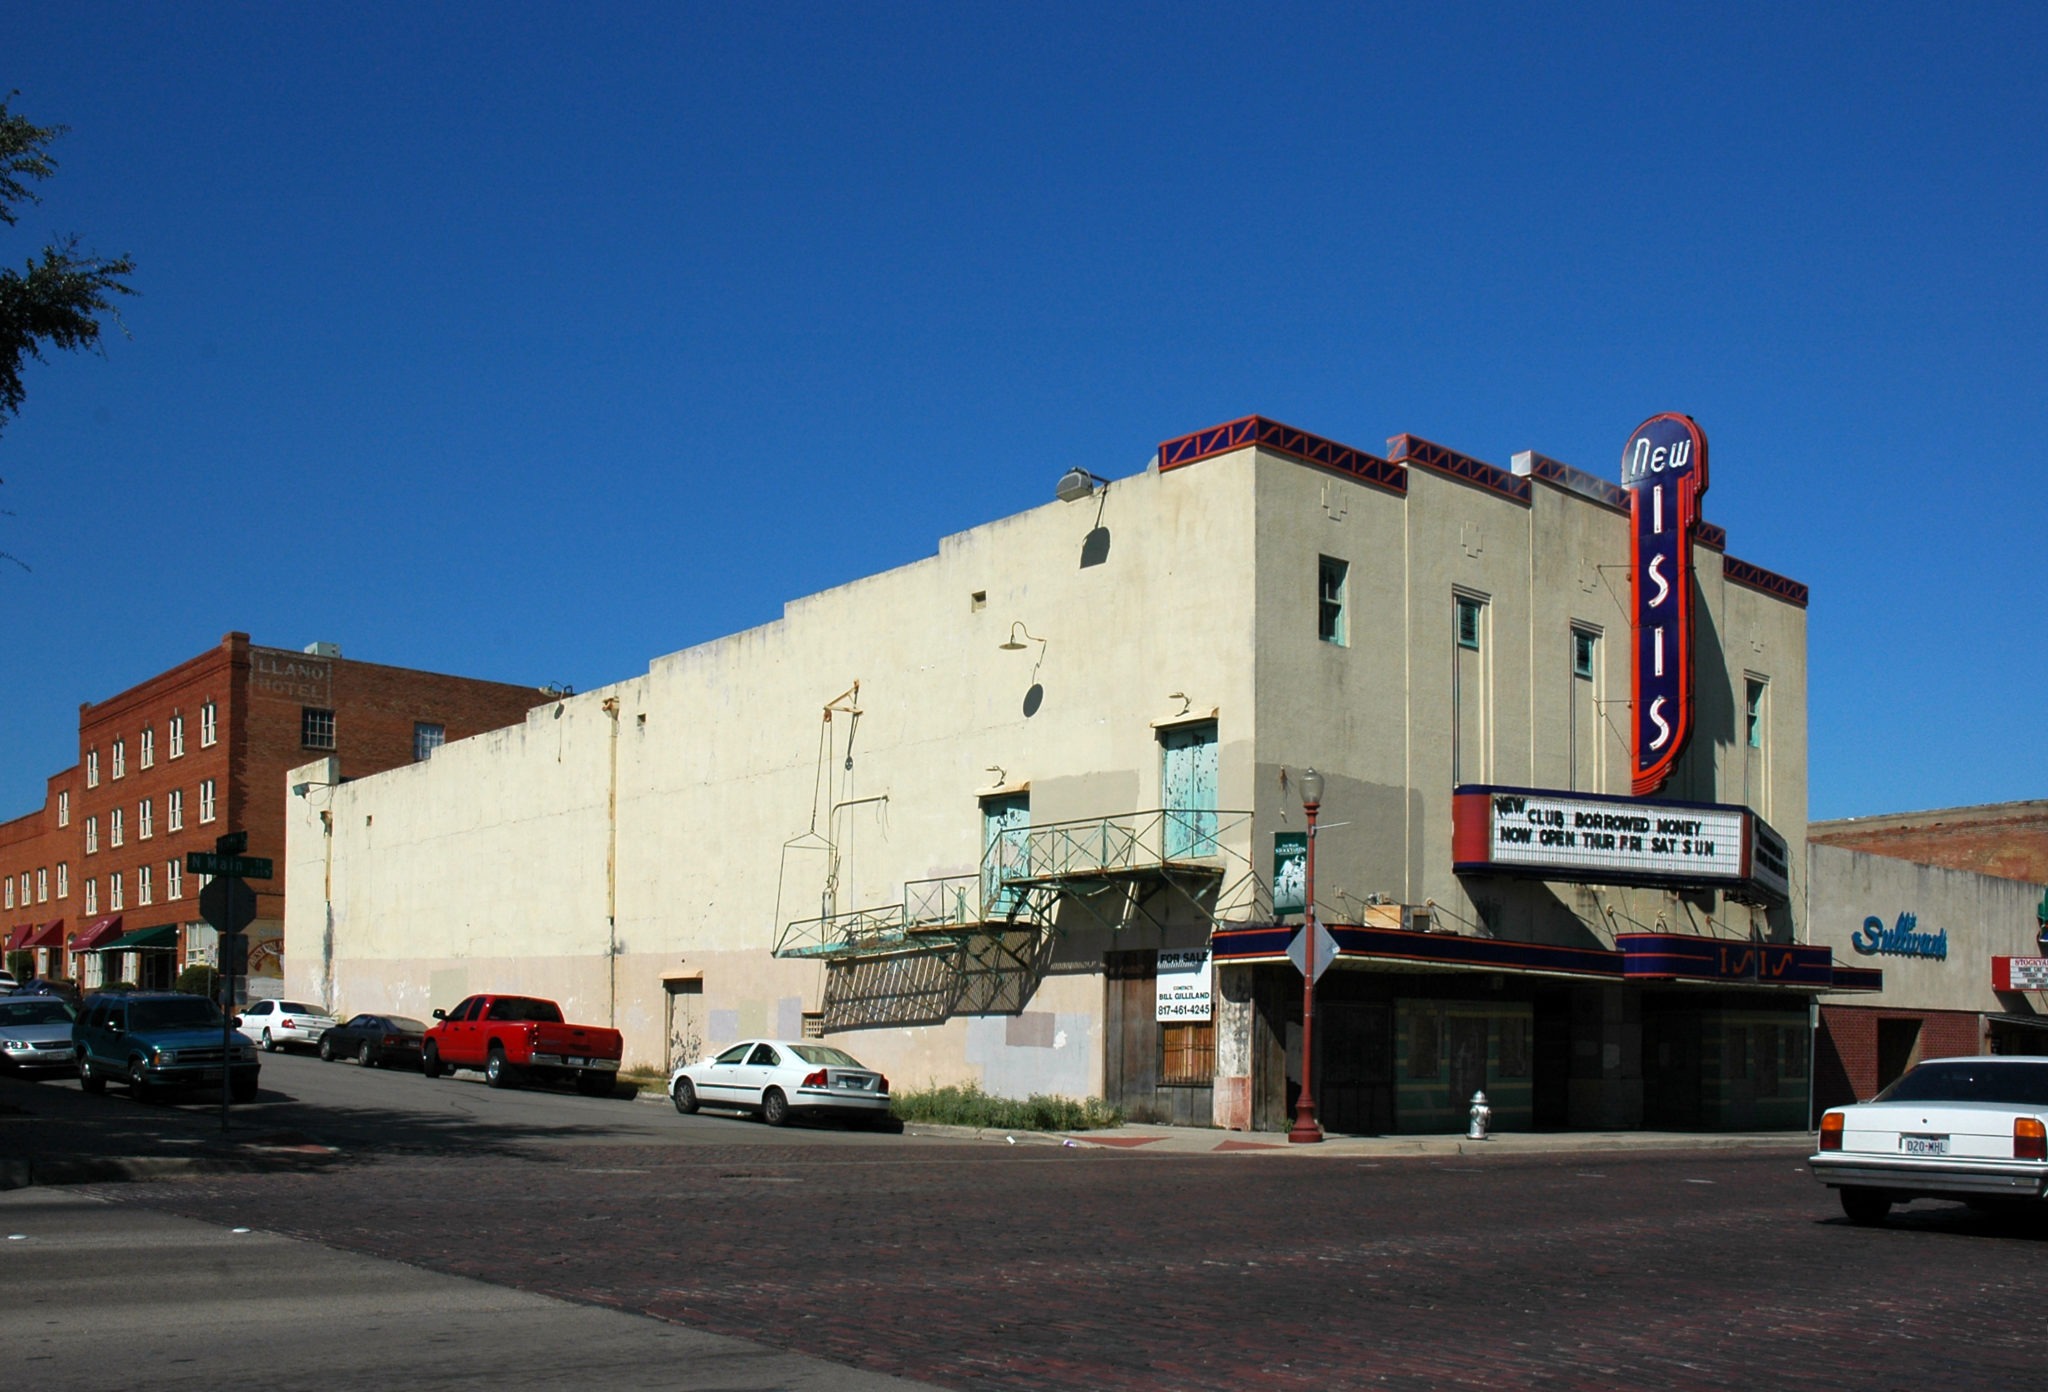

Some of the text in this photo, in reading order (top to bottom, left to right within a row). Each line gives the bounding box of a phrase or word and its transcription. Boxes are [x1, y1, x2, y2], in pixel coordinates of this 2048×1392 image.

[1648, 484, 1670, 751] ISIS
[259, 659, 325, 680] LLANO
[259, 679, 324, 699] HOTEL
[1495, 796, 1702, 837] NEW CLUB BORROWED MONEY
[1500, 826, 1532, 844] NOW
[1539, 829, 1576, 848] OPEN
[1620, 835, 1642, 853] FRI
[1651, 837, 1677, 855] SAT
[1682, 839, 1715, 857] SUN
[192, 856, 201, 868] N
[207, 857, 243, 872] Main
[1160, 953, 1181, 964] FOR
[1183, 951, 1209, 963] SALE
[1720, 946, 1793, 976] ISIS
[2015, 959, 2048, 967] STOCKYA
[1159, 991, 1210, 1001] BILL GILLILAND
[1158, 1004, 1210, 1016] 817-461-4245
